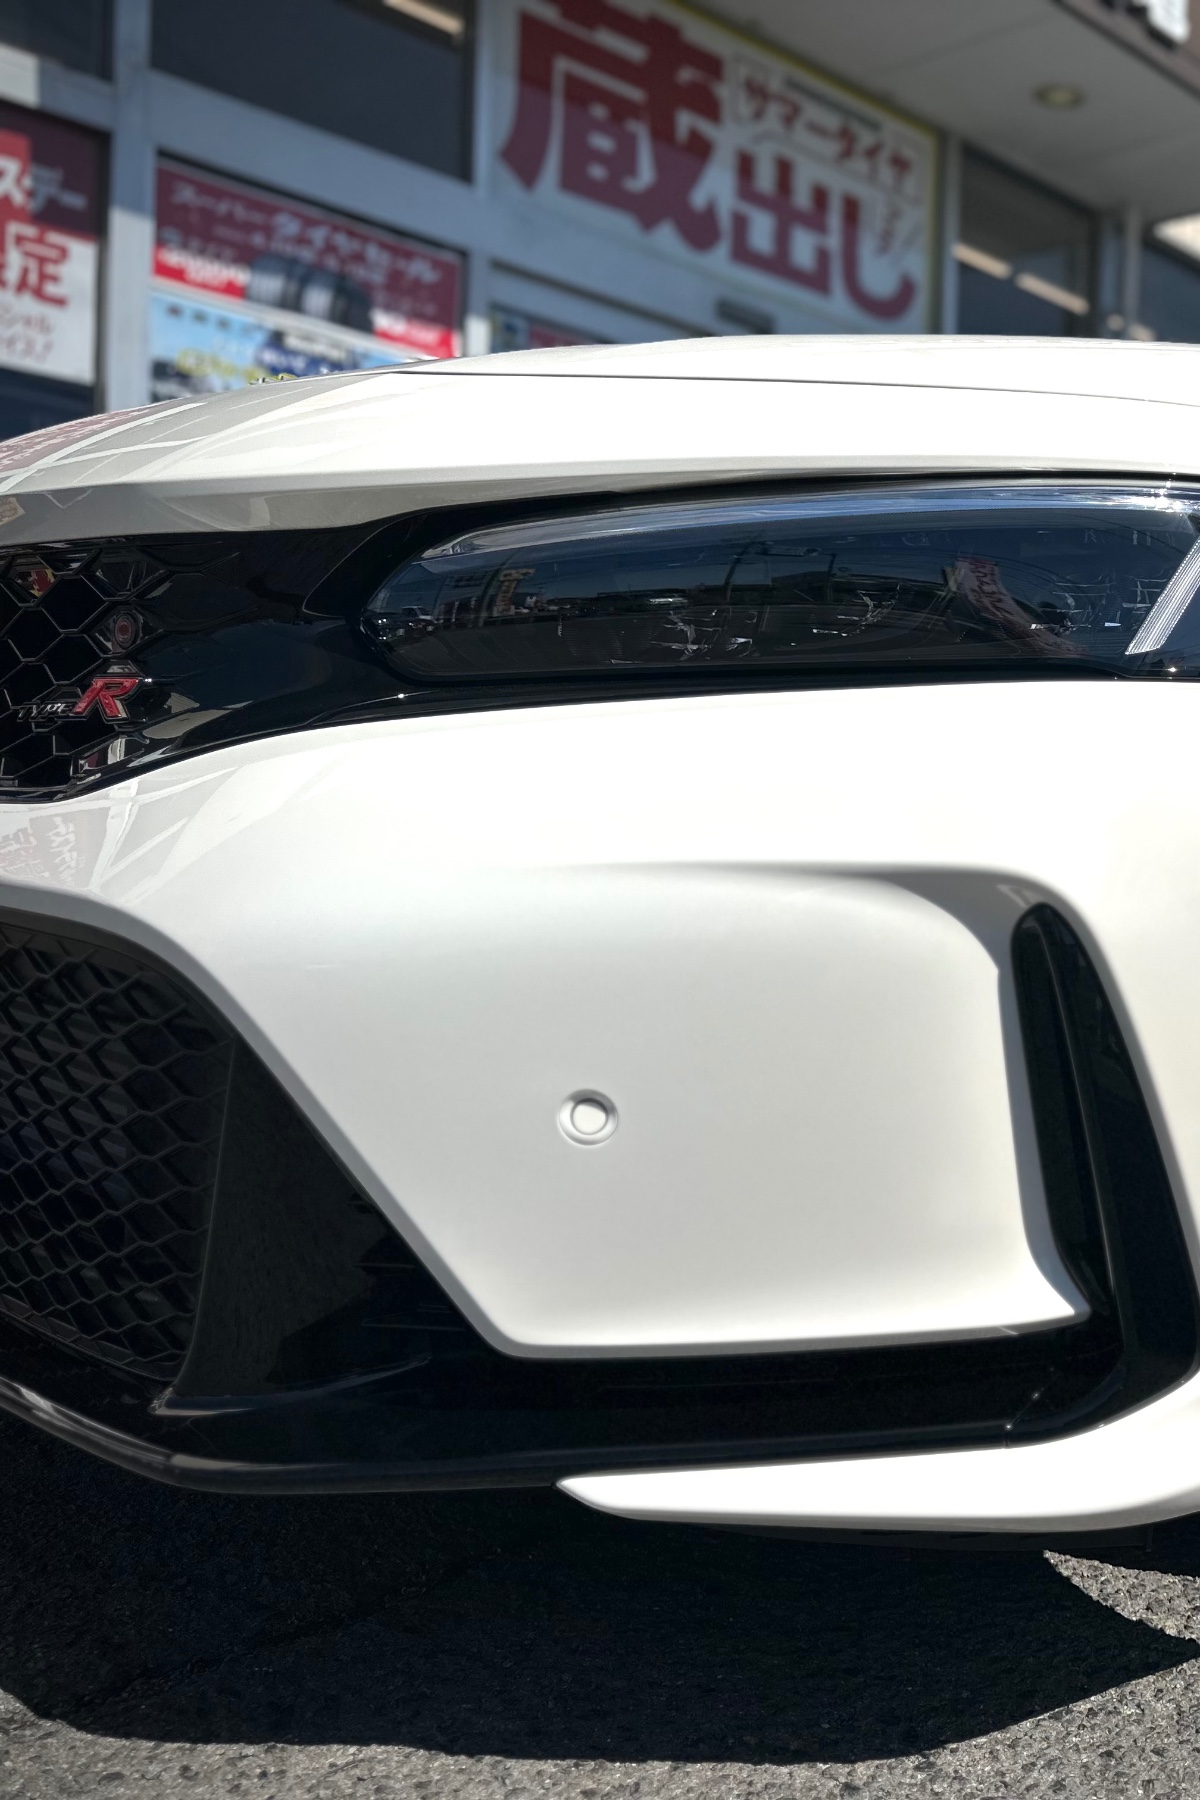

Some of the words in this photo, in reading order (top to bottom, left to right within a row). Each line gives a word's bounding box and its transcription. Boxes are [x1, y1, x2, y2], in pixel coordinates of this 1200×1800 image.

[743, 74, 913, 190] サマータイヤ
[0, 222, 71, 308] 定
[72, 677, 140, 720] R
